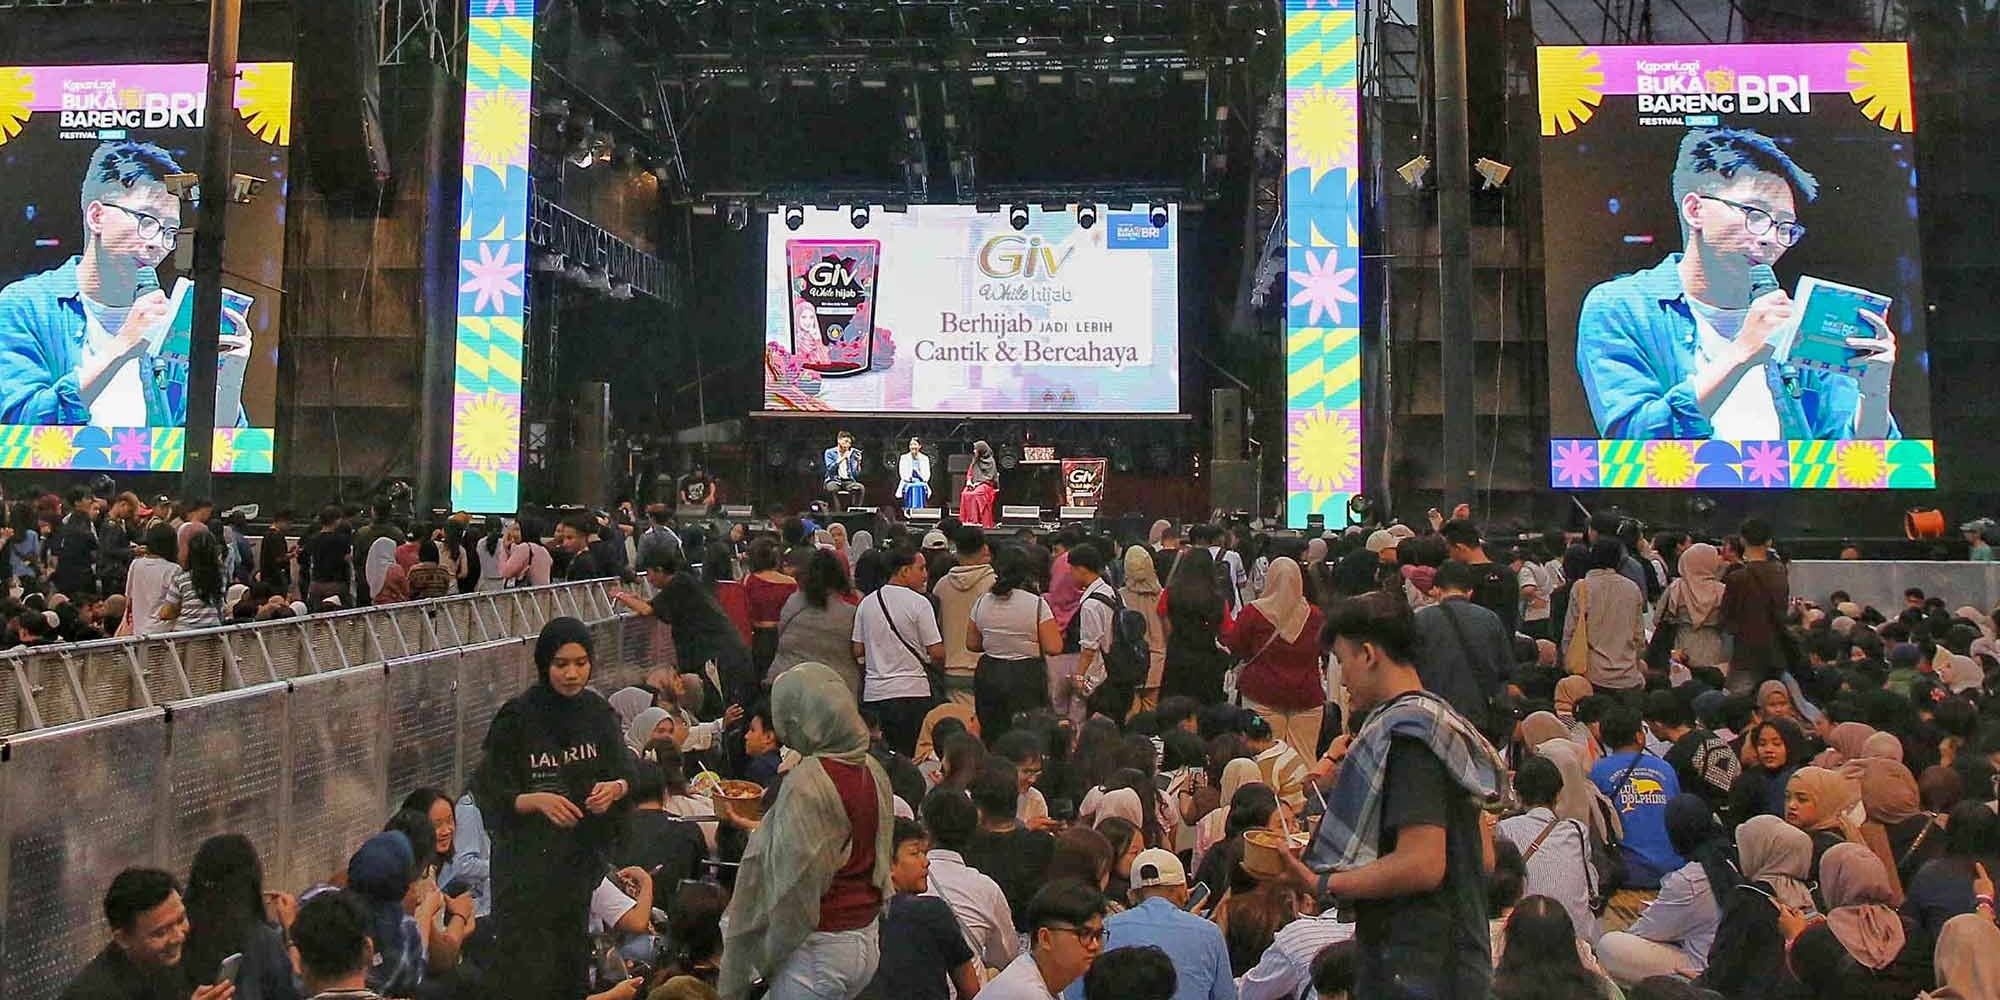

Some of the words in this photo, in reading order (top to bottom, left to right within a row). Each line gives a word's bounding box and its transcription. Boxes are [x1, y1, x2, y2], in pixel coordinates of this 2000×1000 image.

[1636, 60, 1700, 76] KapanLagi
[1637, 76, 1704, 94] BUKA
[1738, 75, 1811, 113] BRI
[62, 94, 117, 109] BUKA
[144, 93, 206, 128] BRI
[1637, 94, 1735, 113] BARENG
[60, 110, 141, 128] BARENG
[1639, 117, 1684, 126] FESTIVAL
[60, 131, 97, 139] FESTIVAL
[978, 235, 1075, 279] Giv
[808, 262, 857, 286] Giv
[835, 288, 857, 300] hijab
[979, 283, 1029, 301] While
[1031, 285, 1073, 305] hijab
[941, 312, 1033, 338] Berhijab
[1040, 322, 1068, 333] JADI
[1076, 322, 1113, 333] LEBIH
[914, 340, 990, 362] Cantik
[995, 340, 1019, 362] &
[1024, 340, 1139, 367] Bercahaya
[1621, 794, 1667, 804] DOLPHINS
